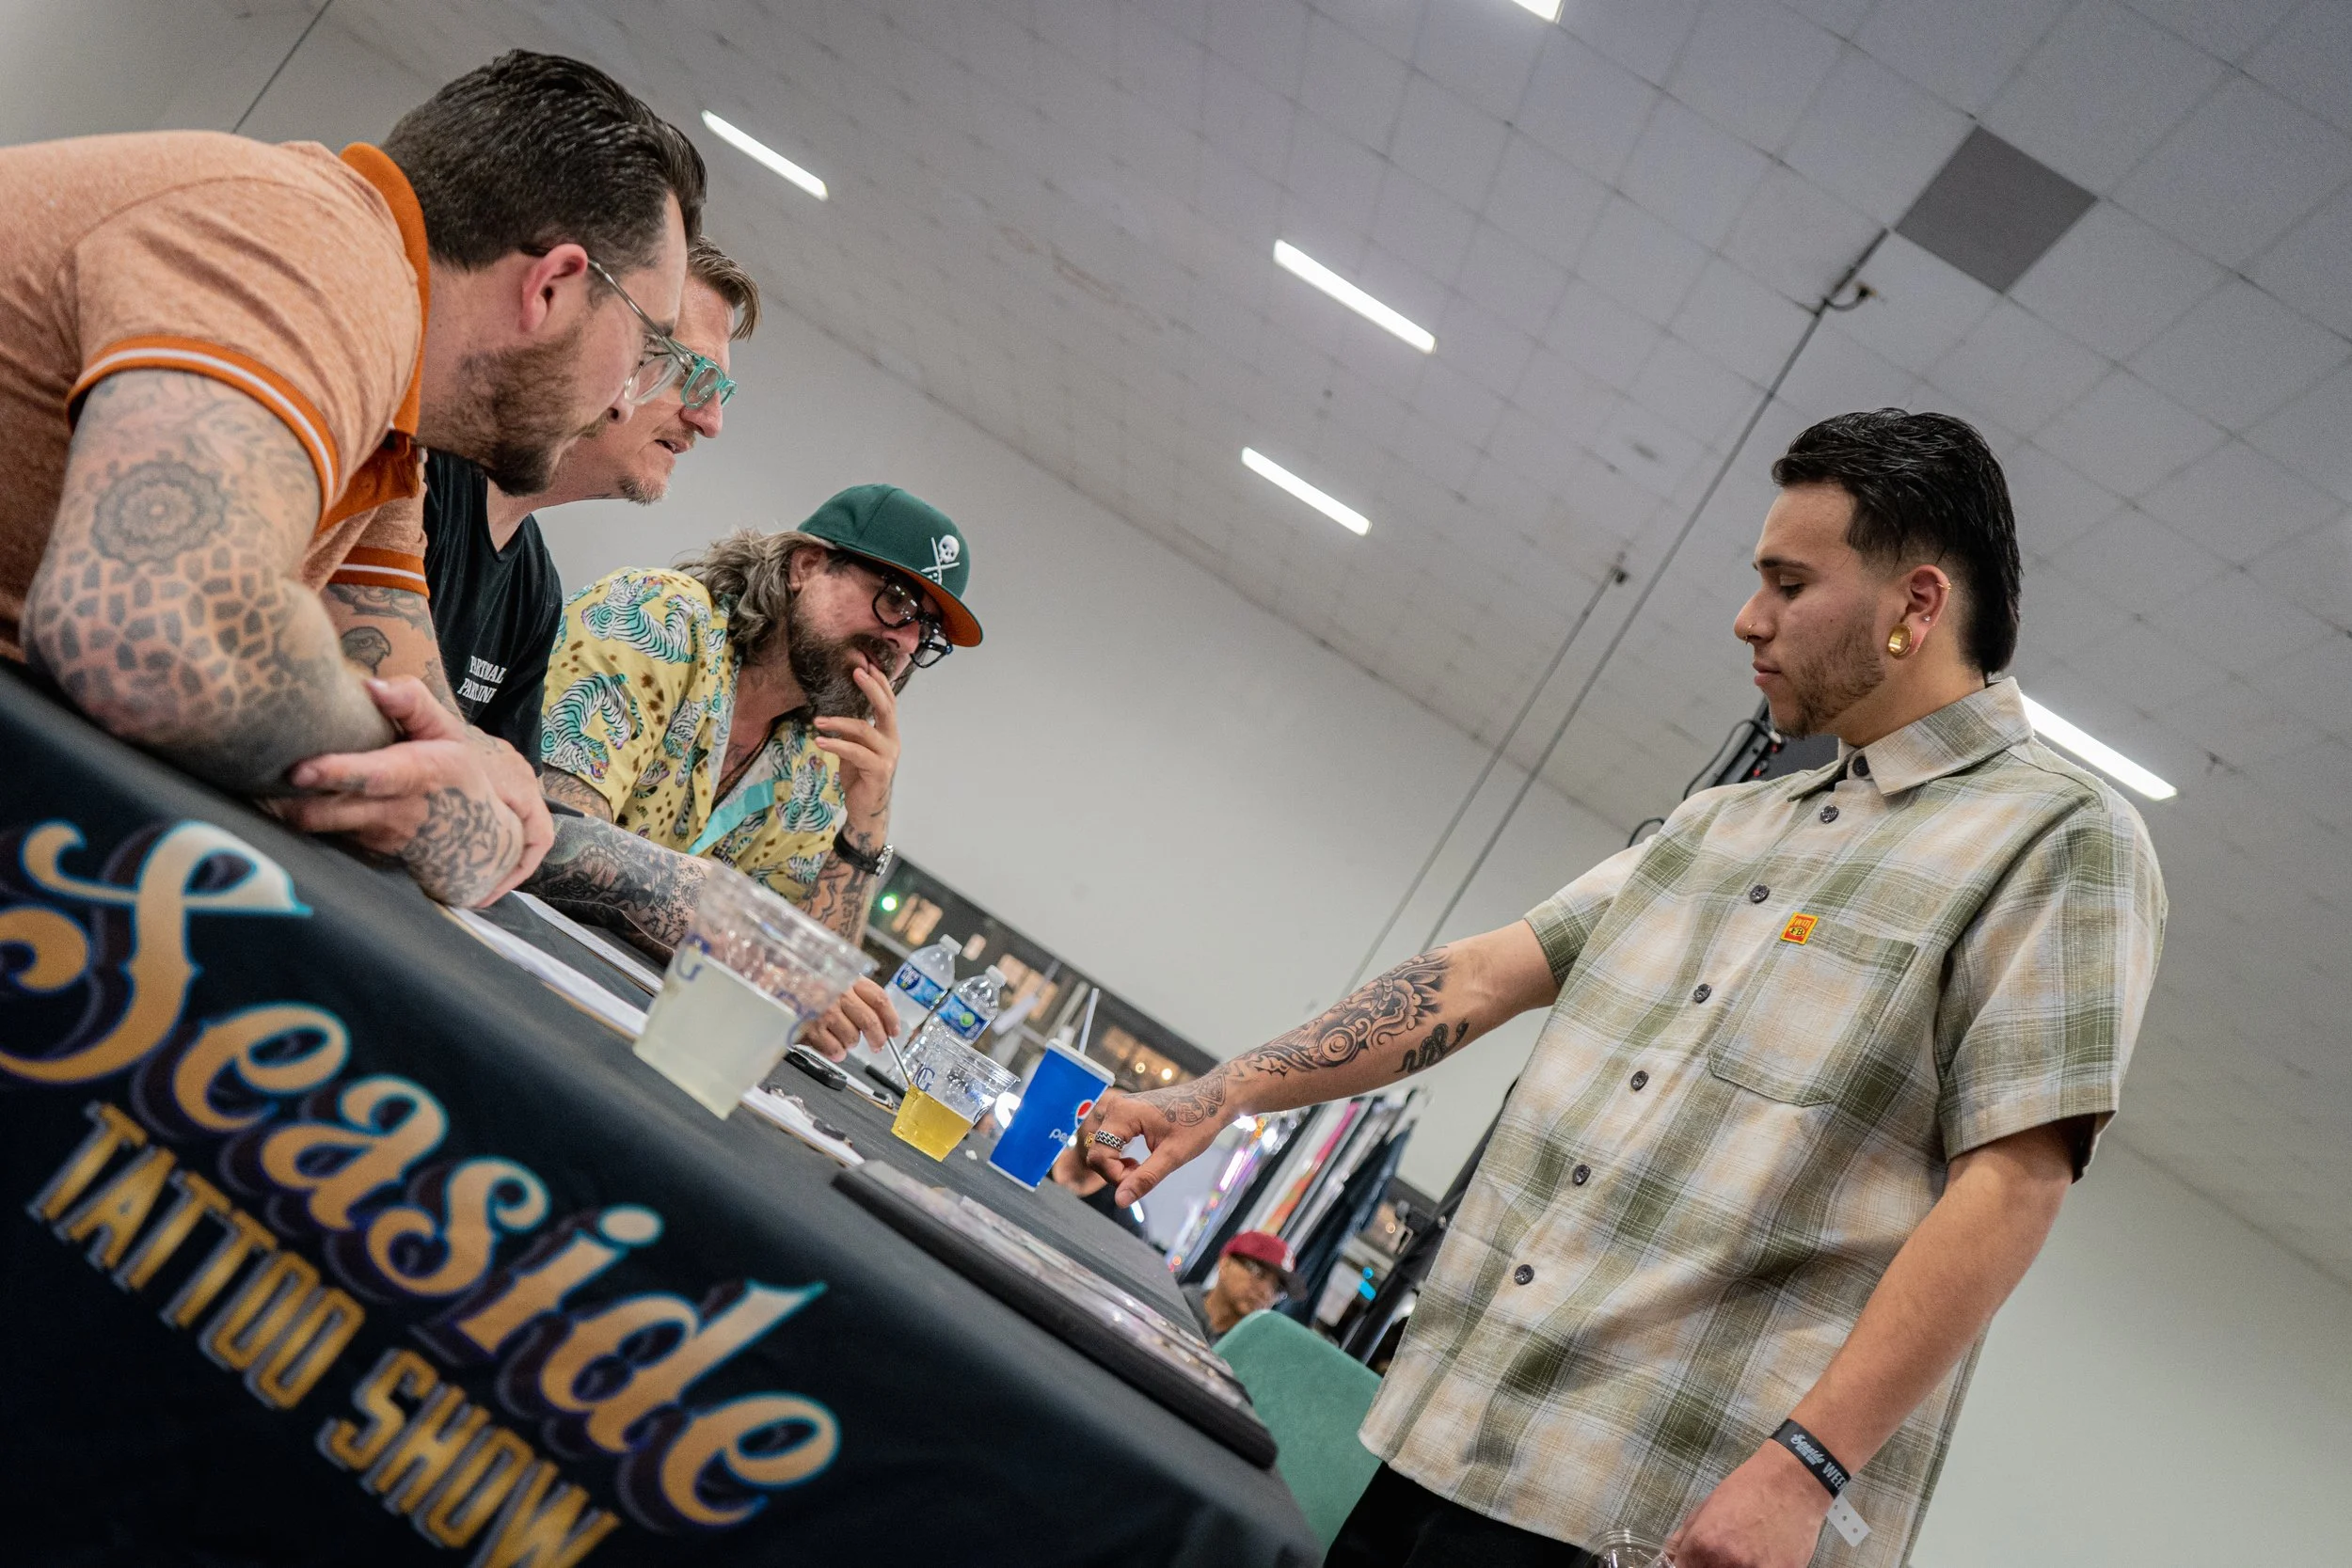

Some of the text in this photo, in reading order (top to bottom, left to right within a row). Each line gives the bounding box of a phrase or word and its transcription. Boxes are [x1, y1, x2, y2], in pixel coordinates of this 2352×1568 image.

[0, 820, 842, 1527] Seaside
[29, 1101, 621, 1568] TATTOO SHOW
[1790, 1433, 1825, 1465] Seaside
